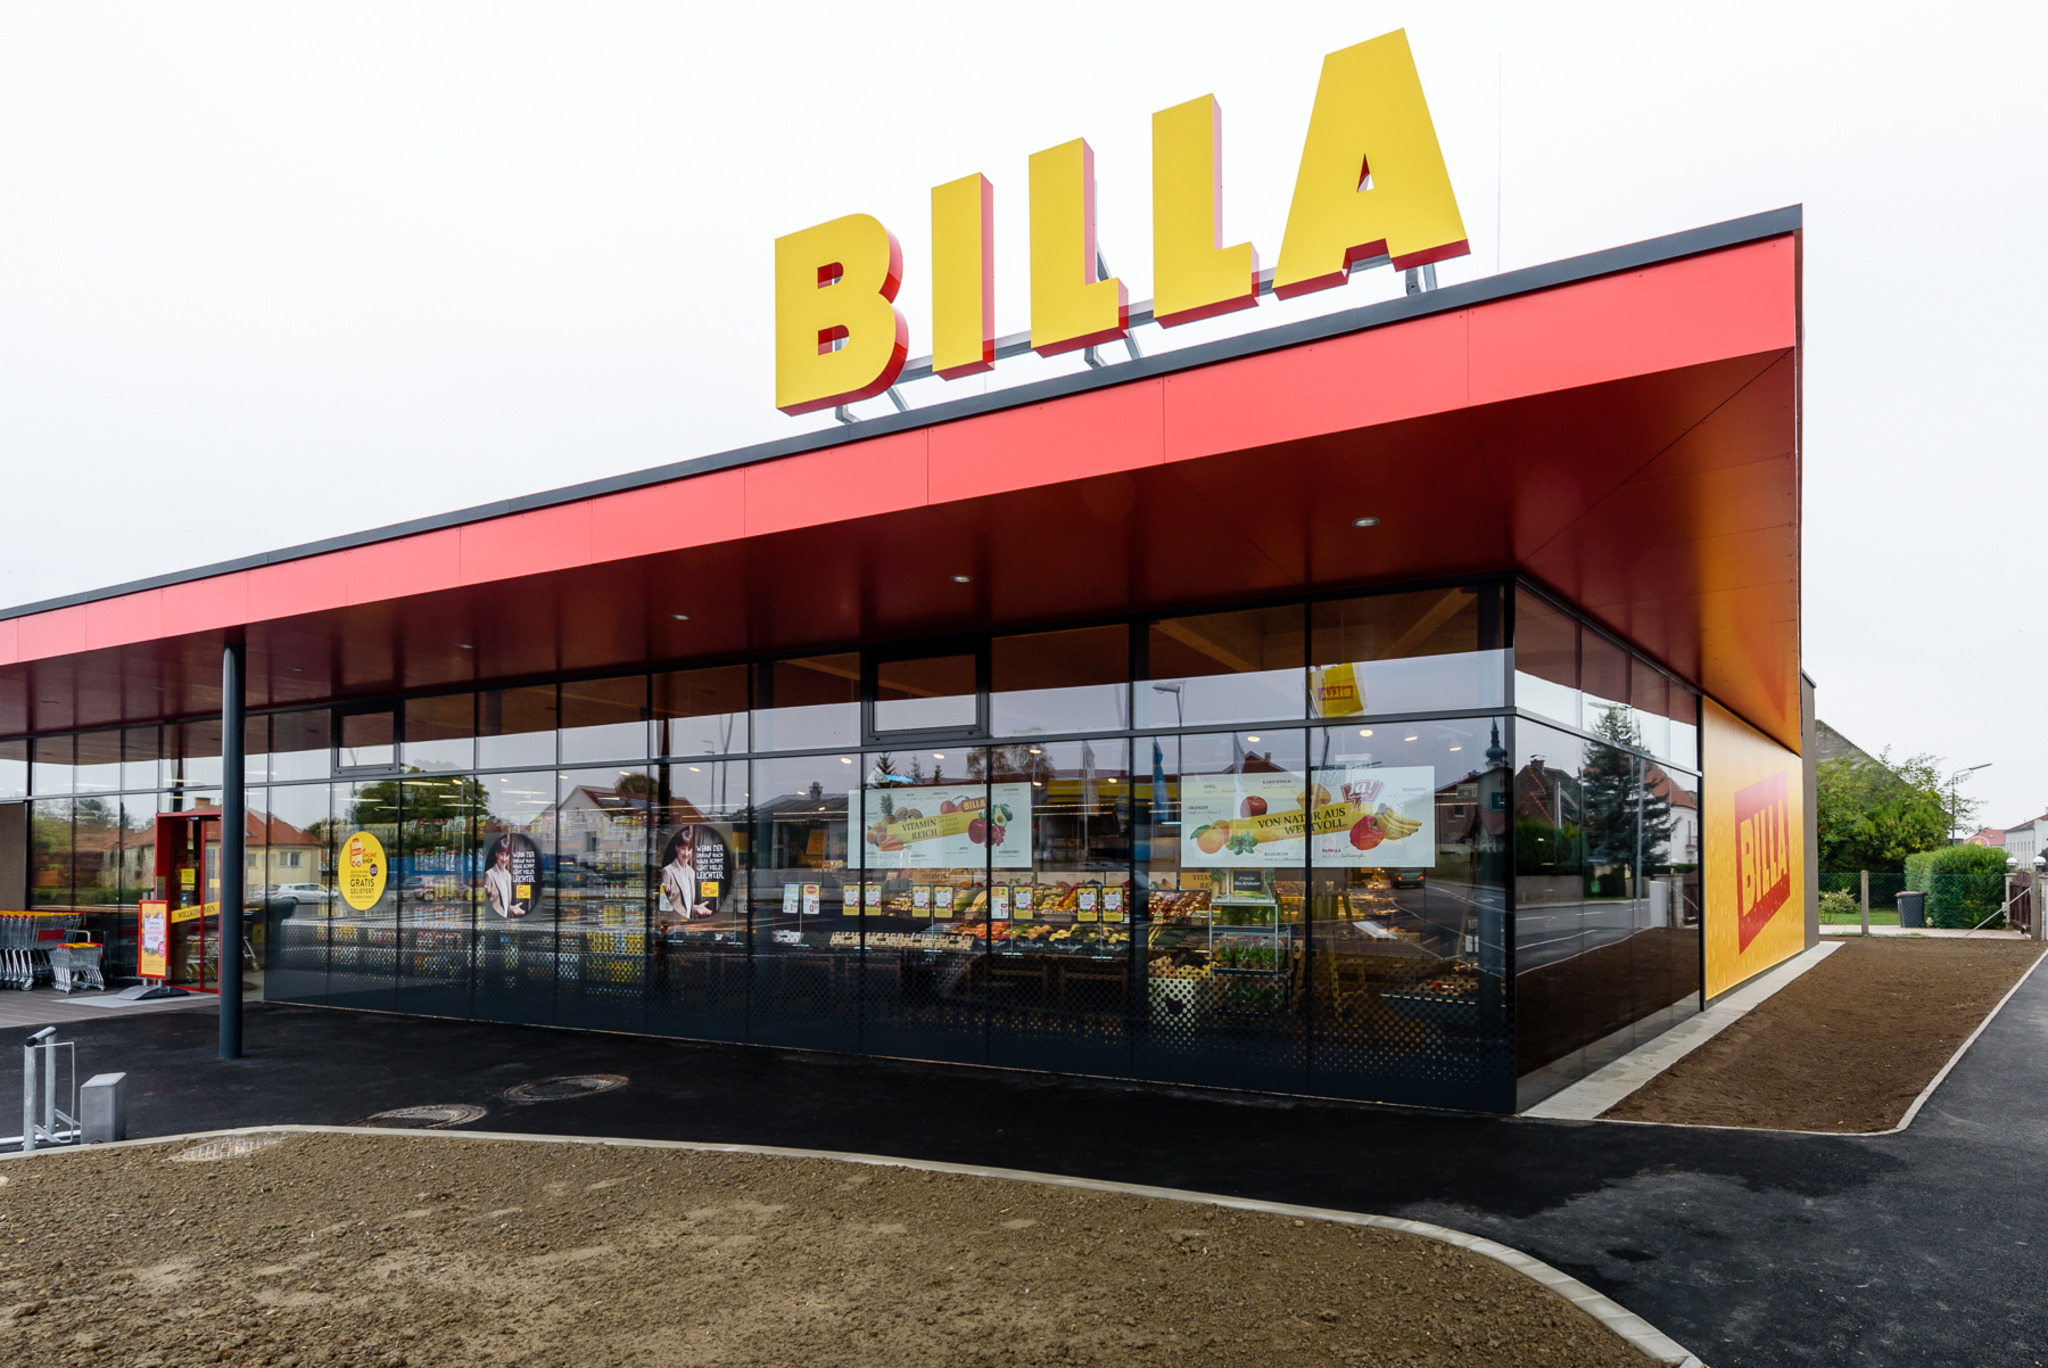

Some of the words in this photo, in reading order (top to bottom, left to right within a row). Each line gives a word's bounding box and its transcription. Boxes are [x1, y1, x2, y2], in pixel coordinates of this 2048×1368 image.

[775, 28, 1470, 416] BILLA
[963, 798, 986, 811] BILLA
[1257, 817, 1281, 829] VON
[1324, 807, 1346, 820] AUS
[902, 819, 937, 832] VITAMIN
[911, 828, 938, 840] REICH
[526, 850, 536, 858] DER
[1740, 799, 1788, 918] BILLA
[350, 878, 375, 887] GRATIS
